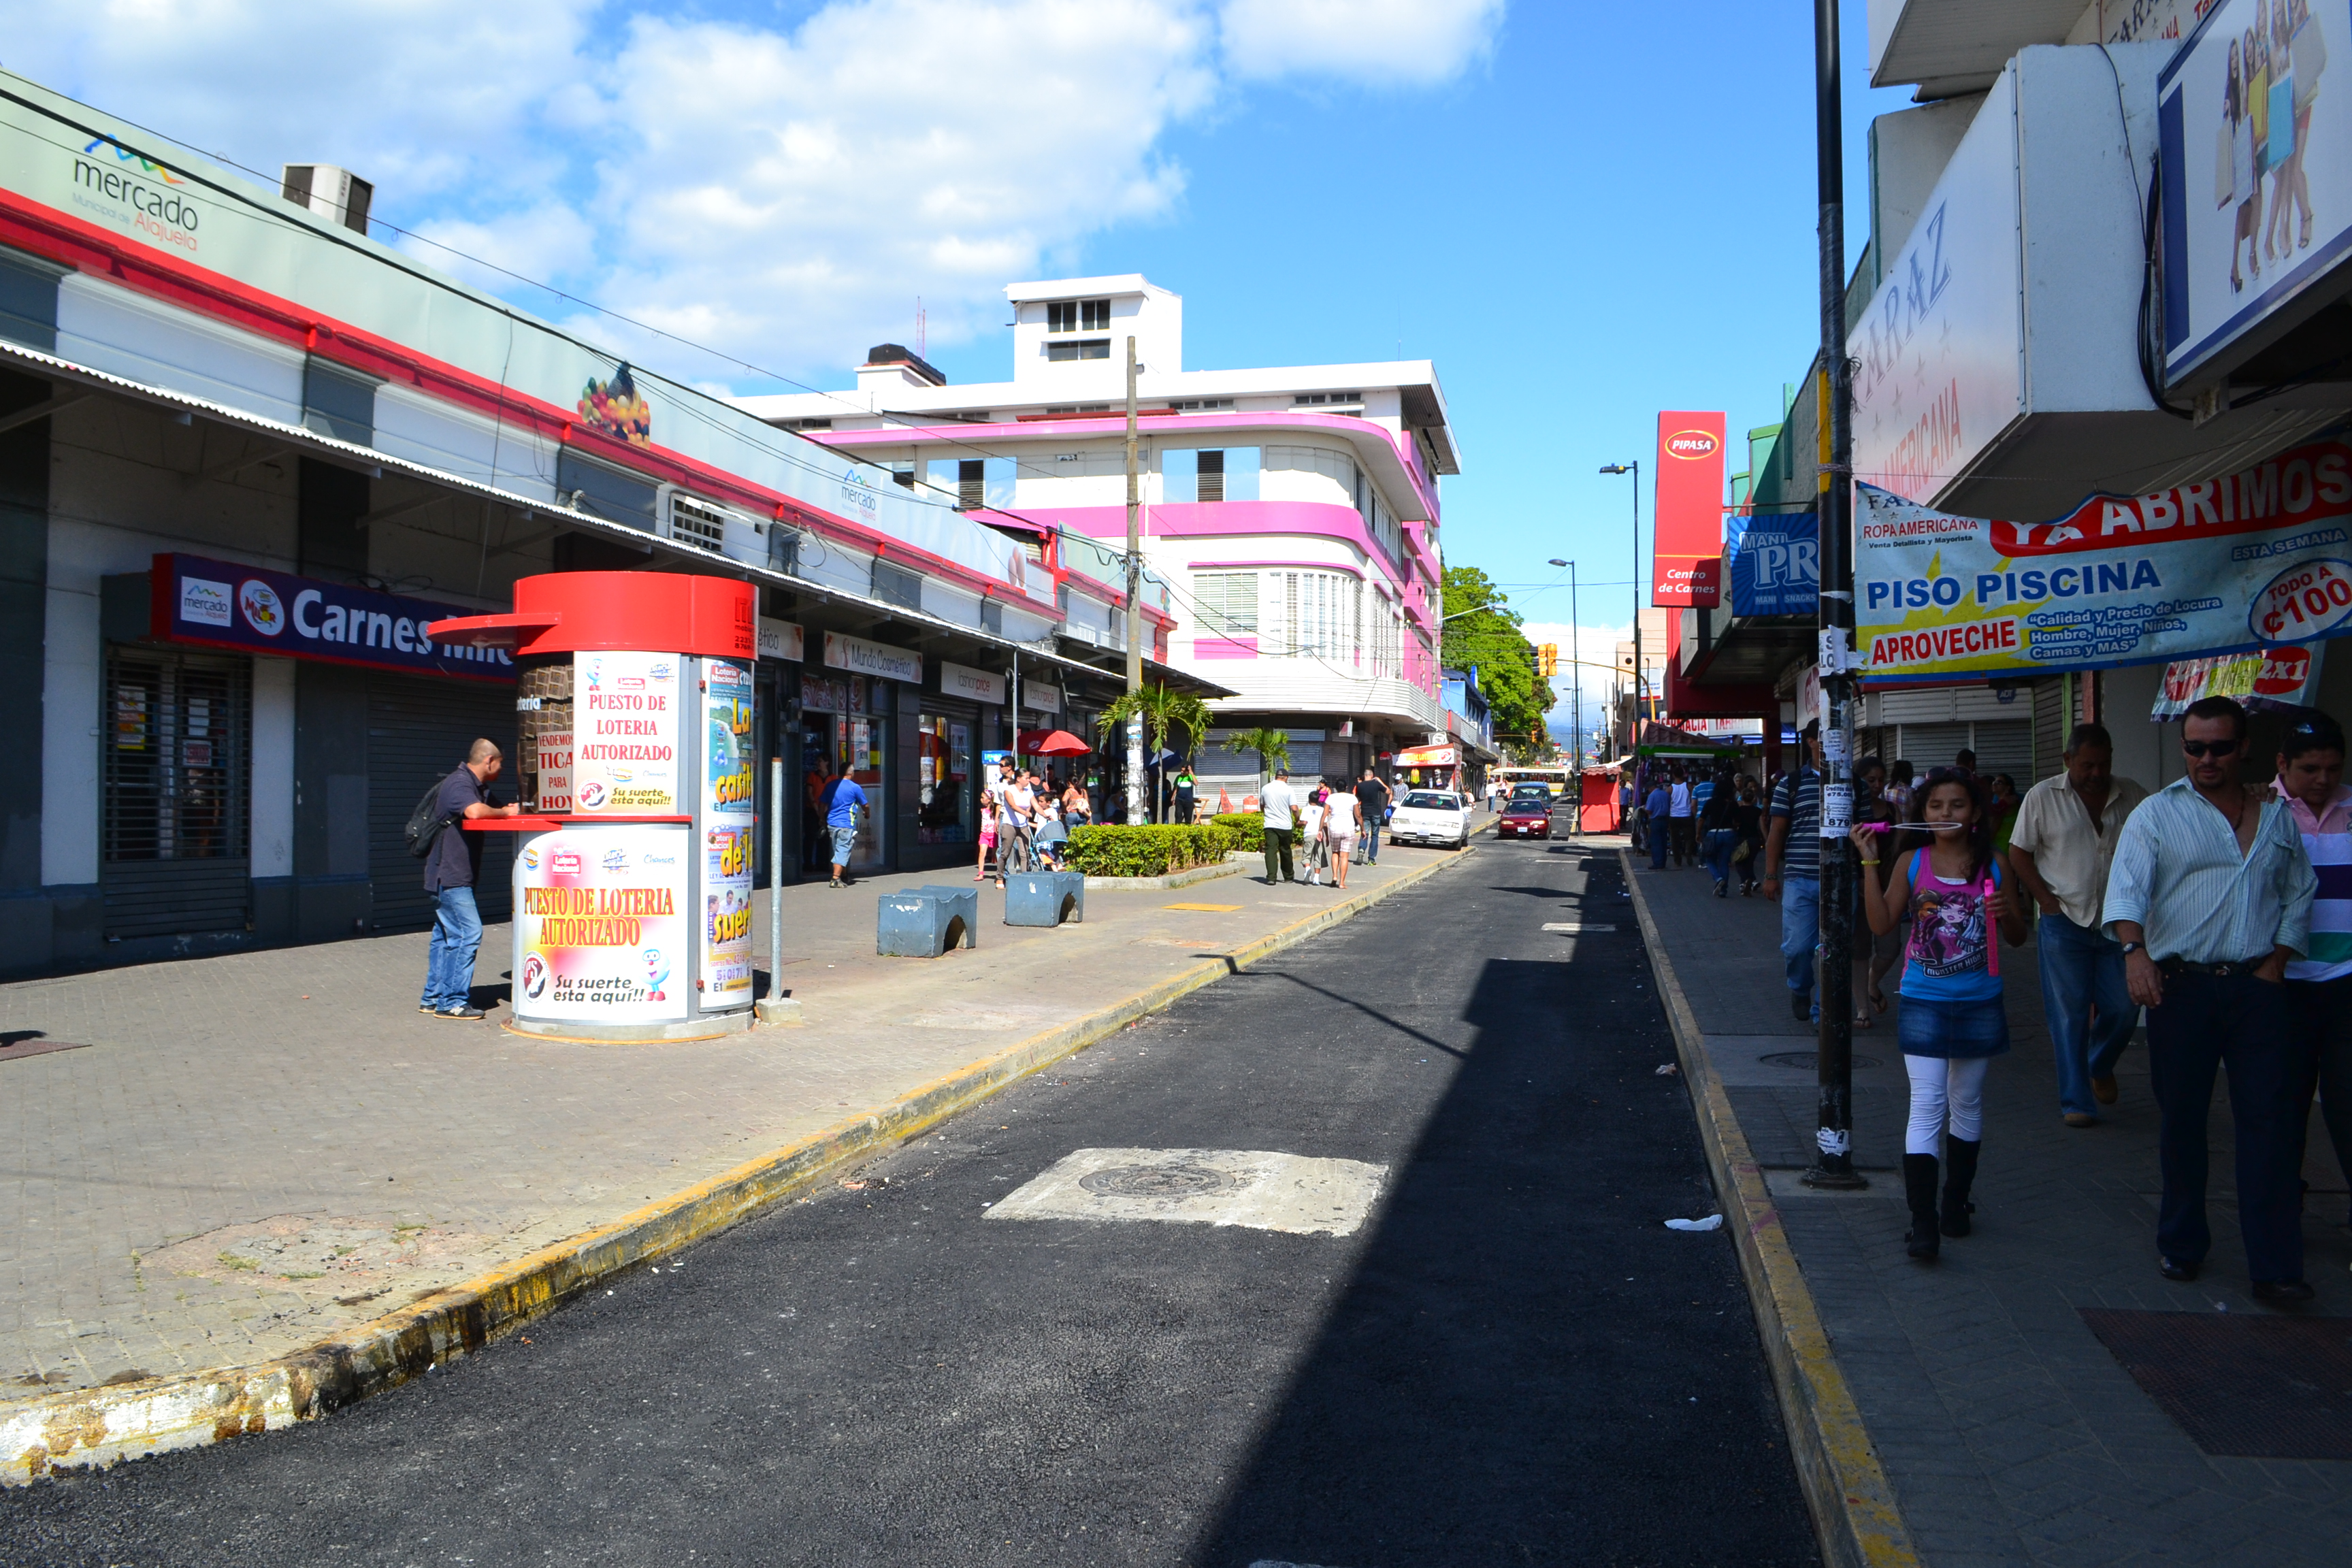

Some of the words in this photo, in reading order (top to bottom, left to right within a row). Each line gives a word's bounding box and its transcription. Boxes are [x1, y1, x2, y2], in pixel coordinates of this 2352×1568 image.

[75, 158, 198, 231] mercado
[134, 212, 198, 251] Alajuela
[1671, 440, 1712, 451] PIPASA
[842, 486, 876, 510] mercado
[2101, 453, 2352, 536] ABRIMOS
[1863, 524, 1897, 539] ROPA
[1899, 519, 1978, 536] AMERICANA
[1743, 534, 1785, 550] MANI
[1893, 539, 1925, 548] Detallista
[1934, 535, 1973, 544] Mayorista
[2232, 545, 2272, 559] ESTA
[2276, 529, 2345, 554] SEMANA
[1758, 540, 1819, 585] PR
[1667, 569, 1706, 579] Centro
[1659, 583, 1672, 593] de
[1675, 583, 1715, 593] Carnes
[1867, 576, 1961, 610] PISO
[1977, 559, 2161, 603] PISCINA
[2268, 572, 2313, 601] TODO
[2319, 566, 2333, 581] A
[184, 596, 228, 612] mercado
[1784, 594, 1816, 602] SNACKS
[2095, 612, 2104, 623] y
[2107, 606, 2152, 619] Precio
[2156, 603, 2172, 613] de
[2175, 599, 2220, 611] Locura
[293, 589, 434, 655] Carnes
[2031, 629, 2092, 642] Hombre,
[2096, 625, 2140, 640] Mujer,
[2144, 620, 2186, 633] Niños,
[1872, 620, 2016, 666] APROVECHE
[852, 644, 877, 669] Mundo
[877, 649, 911, 676] Cosmético
[2032, 647, 2080, 658] Camas
[2084, 647, 2093, 657] y
[711, 674, 739, 684] Nacional
[589, 695, 642, 710] PUESTO
[648, 696, 666, 710] DE
[1999, 690, 2013, 699] ADT
[596, 719, 658, 736] LOTERIA
[581, 745, 672, 761] AUTORIZADO
[549, 777, 567, 788] PARA
[715, 763, 751, 804] casit
[612, 787, 625, 796] Su
[629, 789, 664, 797] suerte
[542, 796, 572, 808] HOY
[637, 796, 672, 806] aquí!!
[553, 864, 579, 872] Nacional
[644, 854, 675, 864] Chances
[525, 887, 568, 915] PUESTO
[572, 888, 595, 915] DE
[600, 888, 674, 915] LOTERIA
[540, 918, 640, 946] AUTORIZADO
[1927, 962, 1964, 975] MONSTER
[1965, 953, 1982, 966] HIGH
[555, 975, 572, 988] Su
[578, 977, 632, 988] suerte
[553, 990, 585, 1001] esta
[591, 988, 644, 1004] aquí!!
